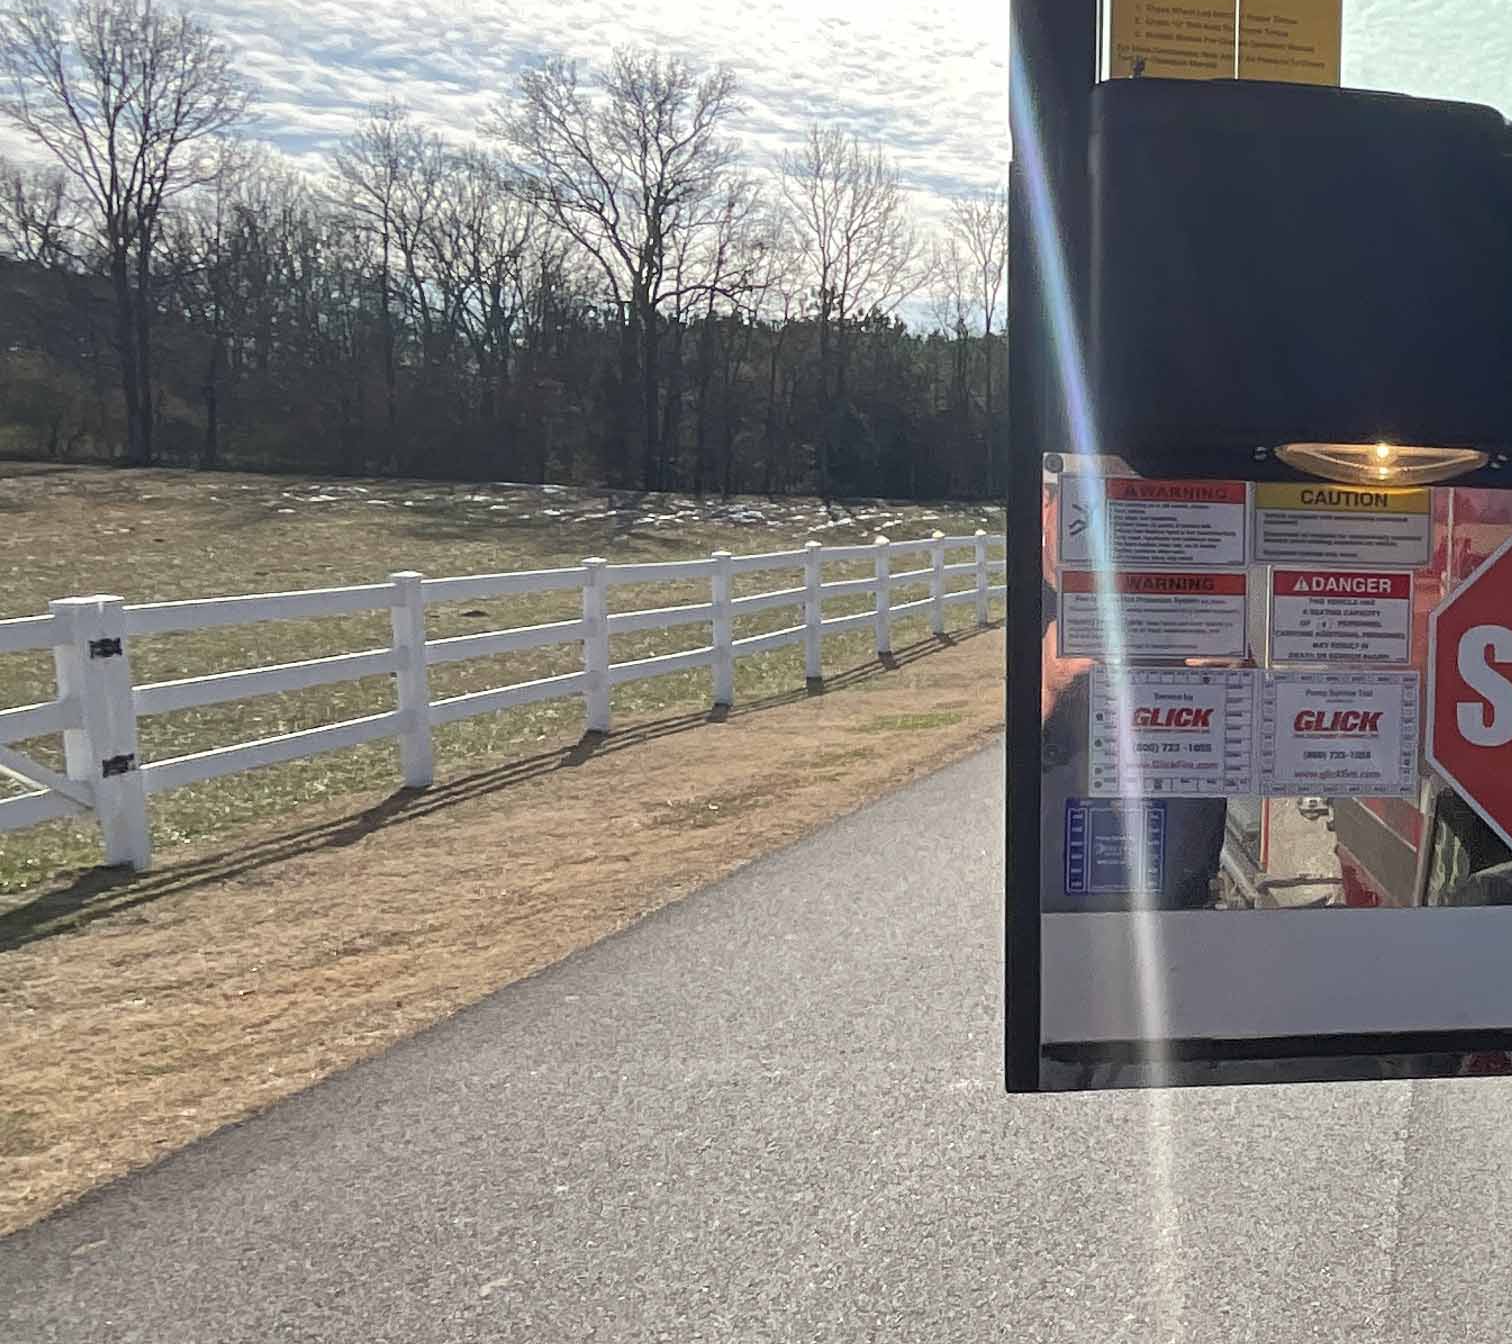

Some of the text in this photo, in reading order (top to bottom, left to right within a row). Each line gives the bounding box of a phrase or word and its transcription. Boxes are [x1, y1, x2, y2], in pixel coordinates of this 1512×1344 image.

[1138, 486, 1228, 499] WARNING
[1301, 490, 1388, 507] CAUTION
[1126, 576, 1215, 592] WARNING
[1312, 576, 1392, 593] DANGER
[1132, 707, 1214, 727] GLICK
[1293, 710, 1384, 732] GLICK
